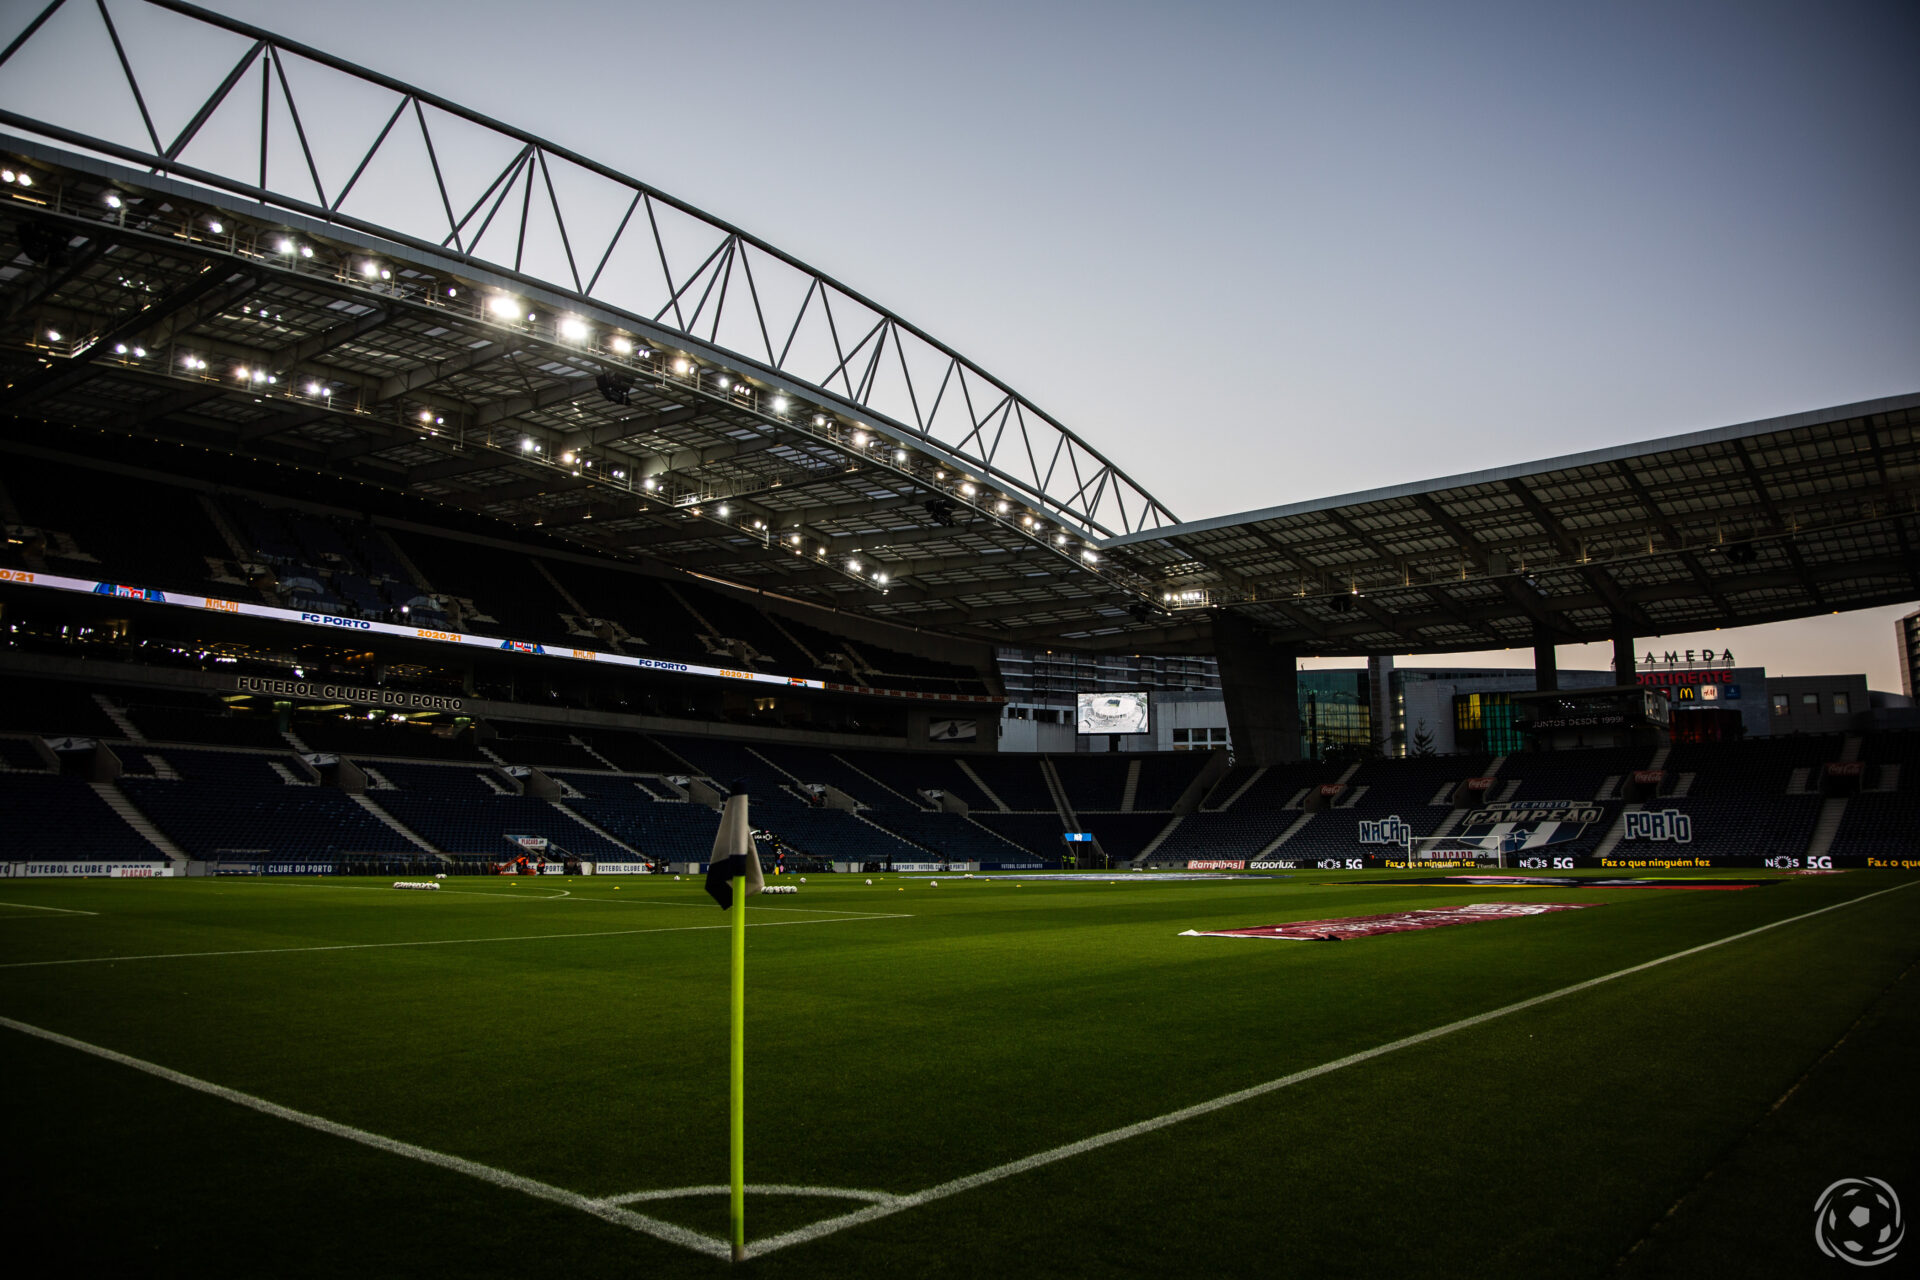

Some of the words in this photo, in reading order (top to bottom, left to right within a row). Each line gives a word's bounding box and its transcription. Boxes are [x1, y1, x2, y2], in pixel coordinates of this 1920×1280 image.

[301, 613, 320, 623] FC
[323, 614, 371, 630] PORTO
[417, 629, 462, 642] 2020/21
[1611, 647, 1734, 665] AMEDA
[639, 659, 652, 668] FC
[654, 661, 688, 671] PORTO
[719, 669, 754, 680] 2020/21
[1634, 669, 1735, 686] ONTINENTE
[237, 677, 318, 696] FUTEBOL
[322, 685, 379, 703] CLUBE
[383, 690, 406, 705] DO
[410, 694, 463, 710] PORTO
[1624, 810, 1691, 842] PORTO
[26, 864, 69, 874] FUTEBOL
[72, 864, 105, 874] CLUBE
[268, 864, 293, 873] CLUBE
[295, 864, 306, 873] DO
[307, 864, 333, 873] PORTO
[1317, 858, 1341, 869] NOS
[1345, 858, 1363, 869] 5G
[1519, 857, 1548, 869] NOS
[1552, 857, 1574, 869] 5G
[1601, 858, 1618, 867] Faz
[1627, 860, 1647, 869] que
[1648, 857, 1692, 869] ninguém
[1694, 857, 1711, 867] fez
[1764, 856, 1800, 869] NOS
[1807, 856, 1833, 869] 5G
[1867, 857, 1888, 867] Faz
[1890, 859, 1899, 867] o
